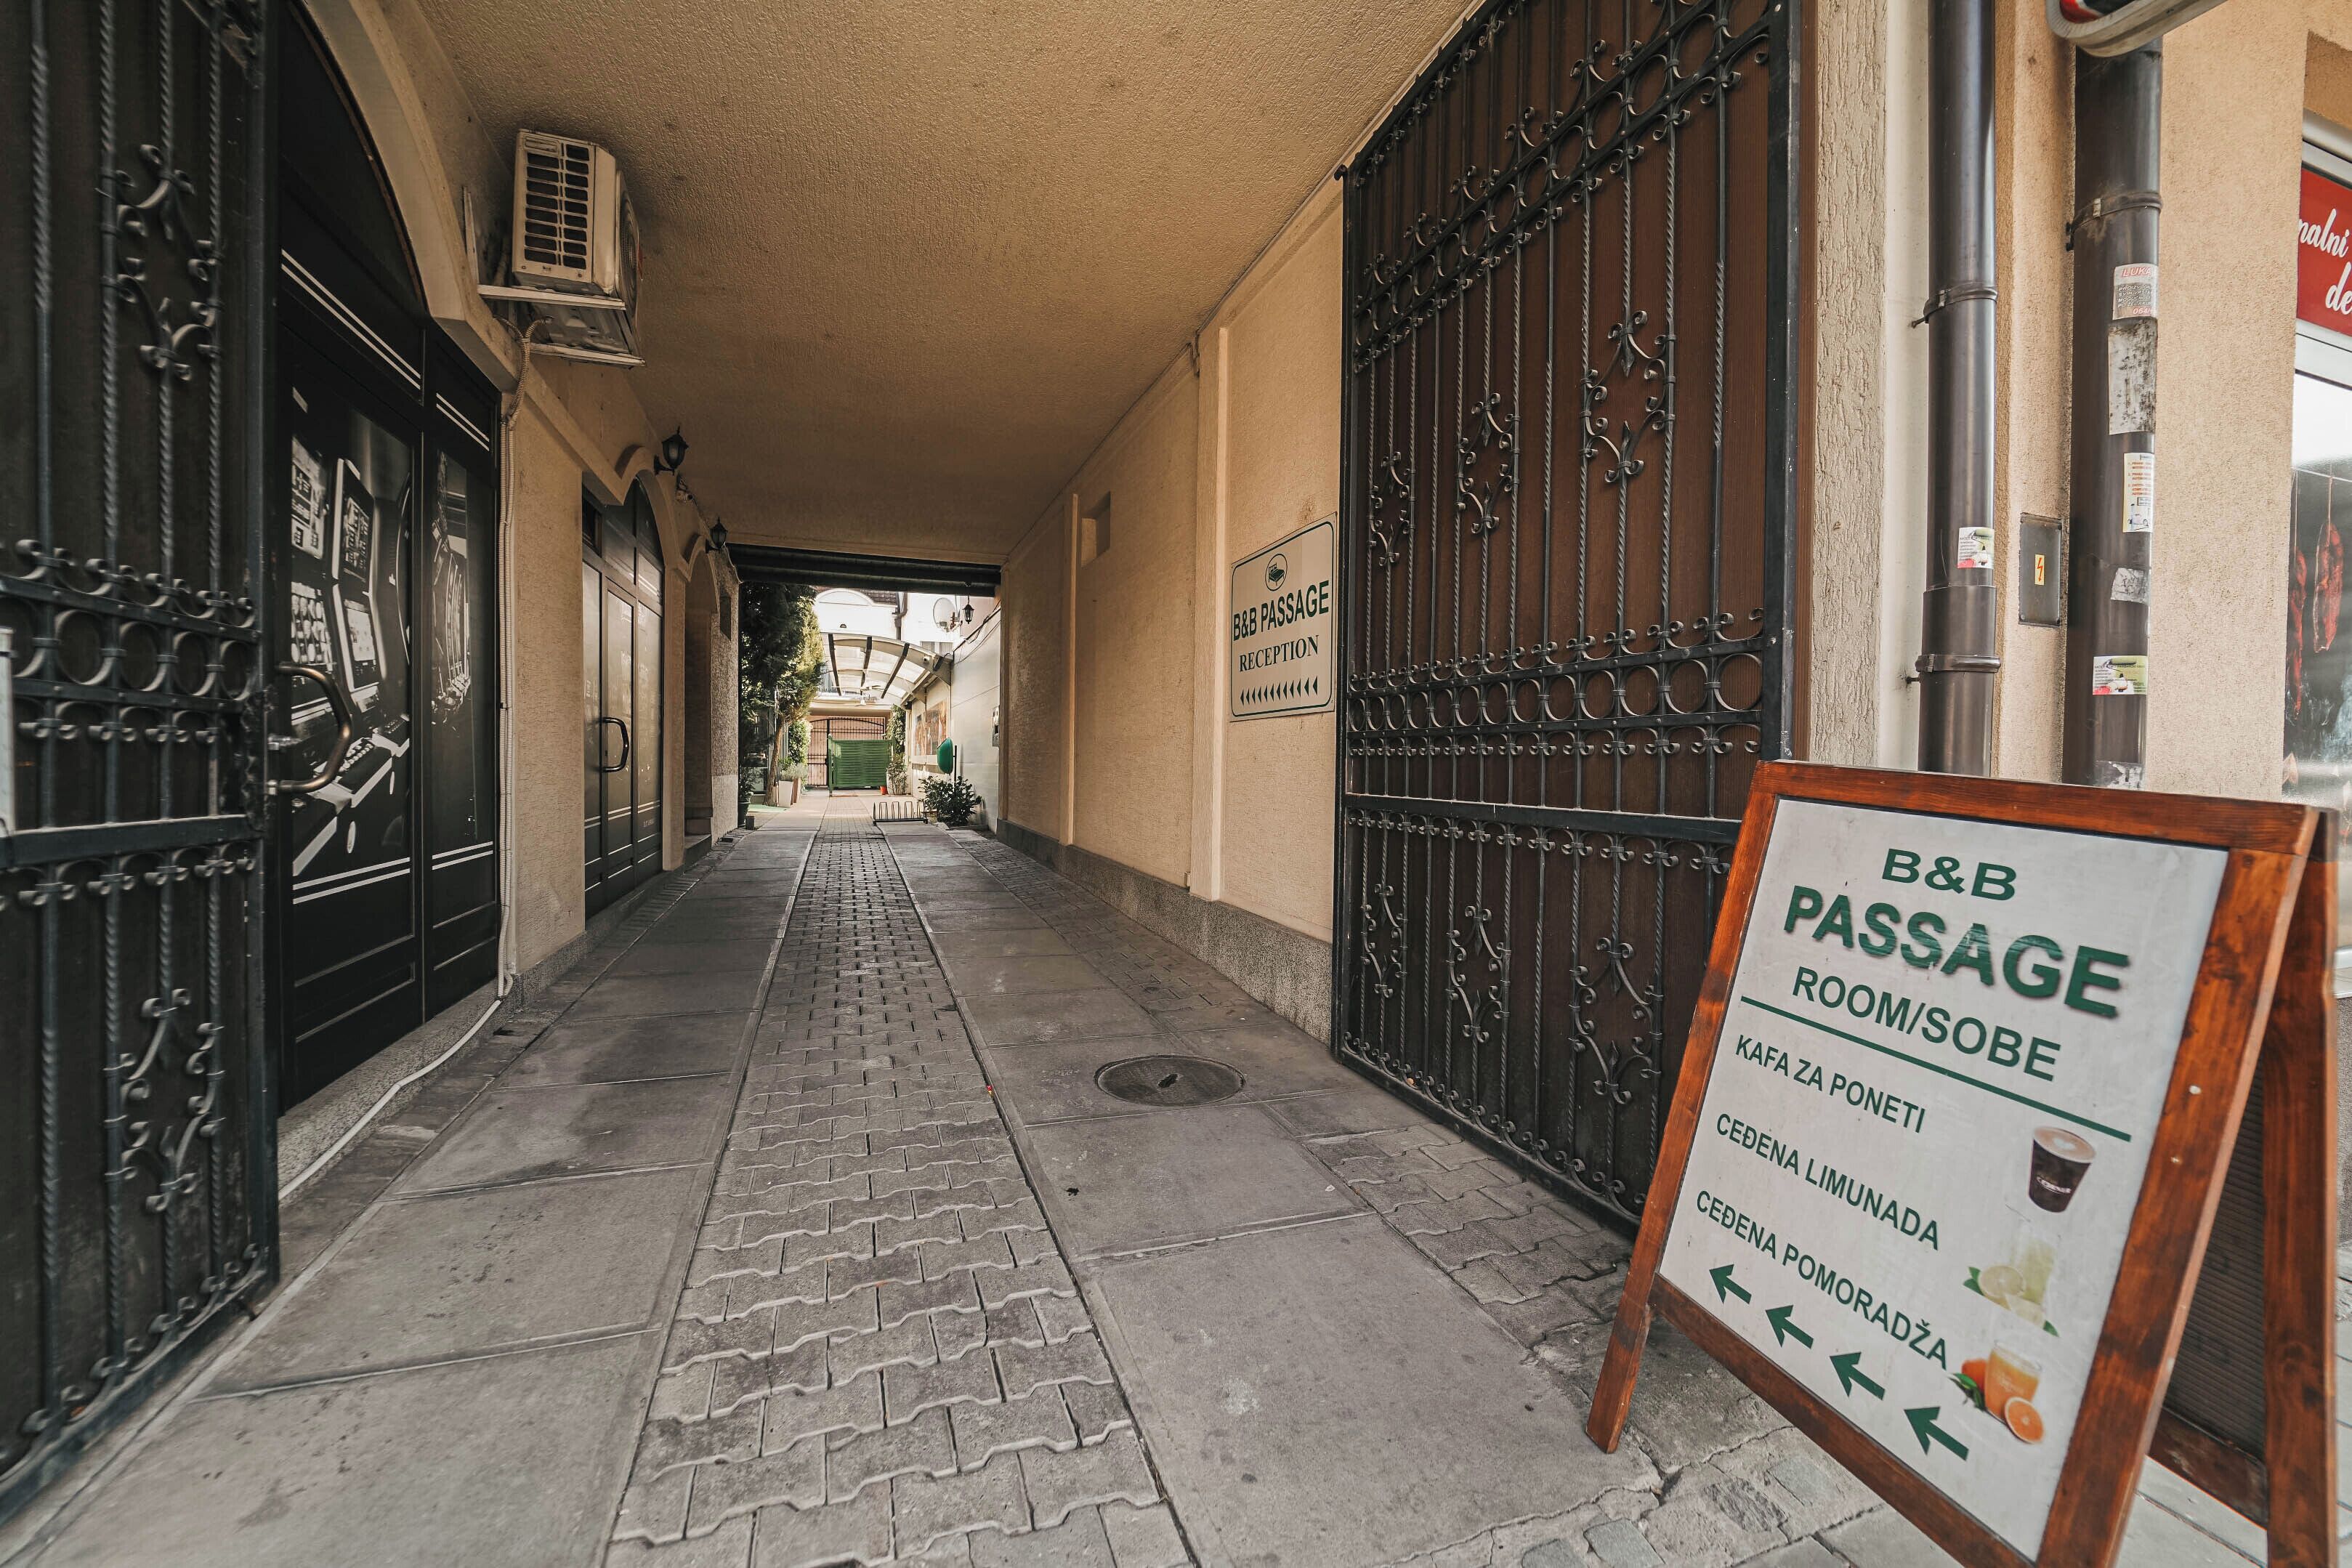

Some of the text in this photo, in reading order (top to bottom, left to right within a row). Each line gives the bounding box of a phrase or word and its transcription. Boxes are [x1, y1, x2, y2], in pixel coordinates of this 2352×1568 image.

[1233, 580, 1329, 641] B&B PASSAGE
[1239, 635, 1319, 672] RECEPTION
[1883, 848, 2018, 901] B&B
[1784, 885, 2130, 1018] PASSAGE
[1793, 966, 2062, 1082] ROOM/SOBE
[1735, 1035, 1926, 1134] KAFA ZA PONETI
[1717, 1113, 1939, 1250] CEĐENA LIMUNADA
[1697, 1190, 1948, 1370] CEĐENA POMORADŽA
